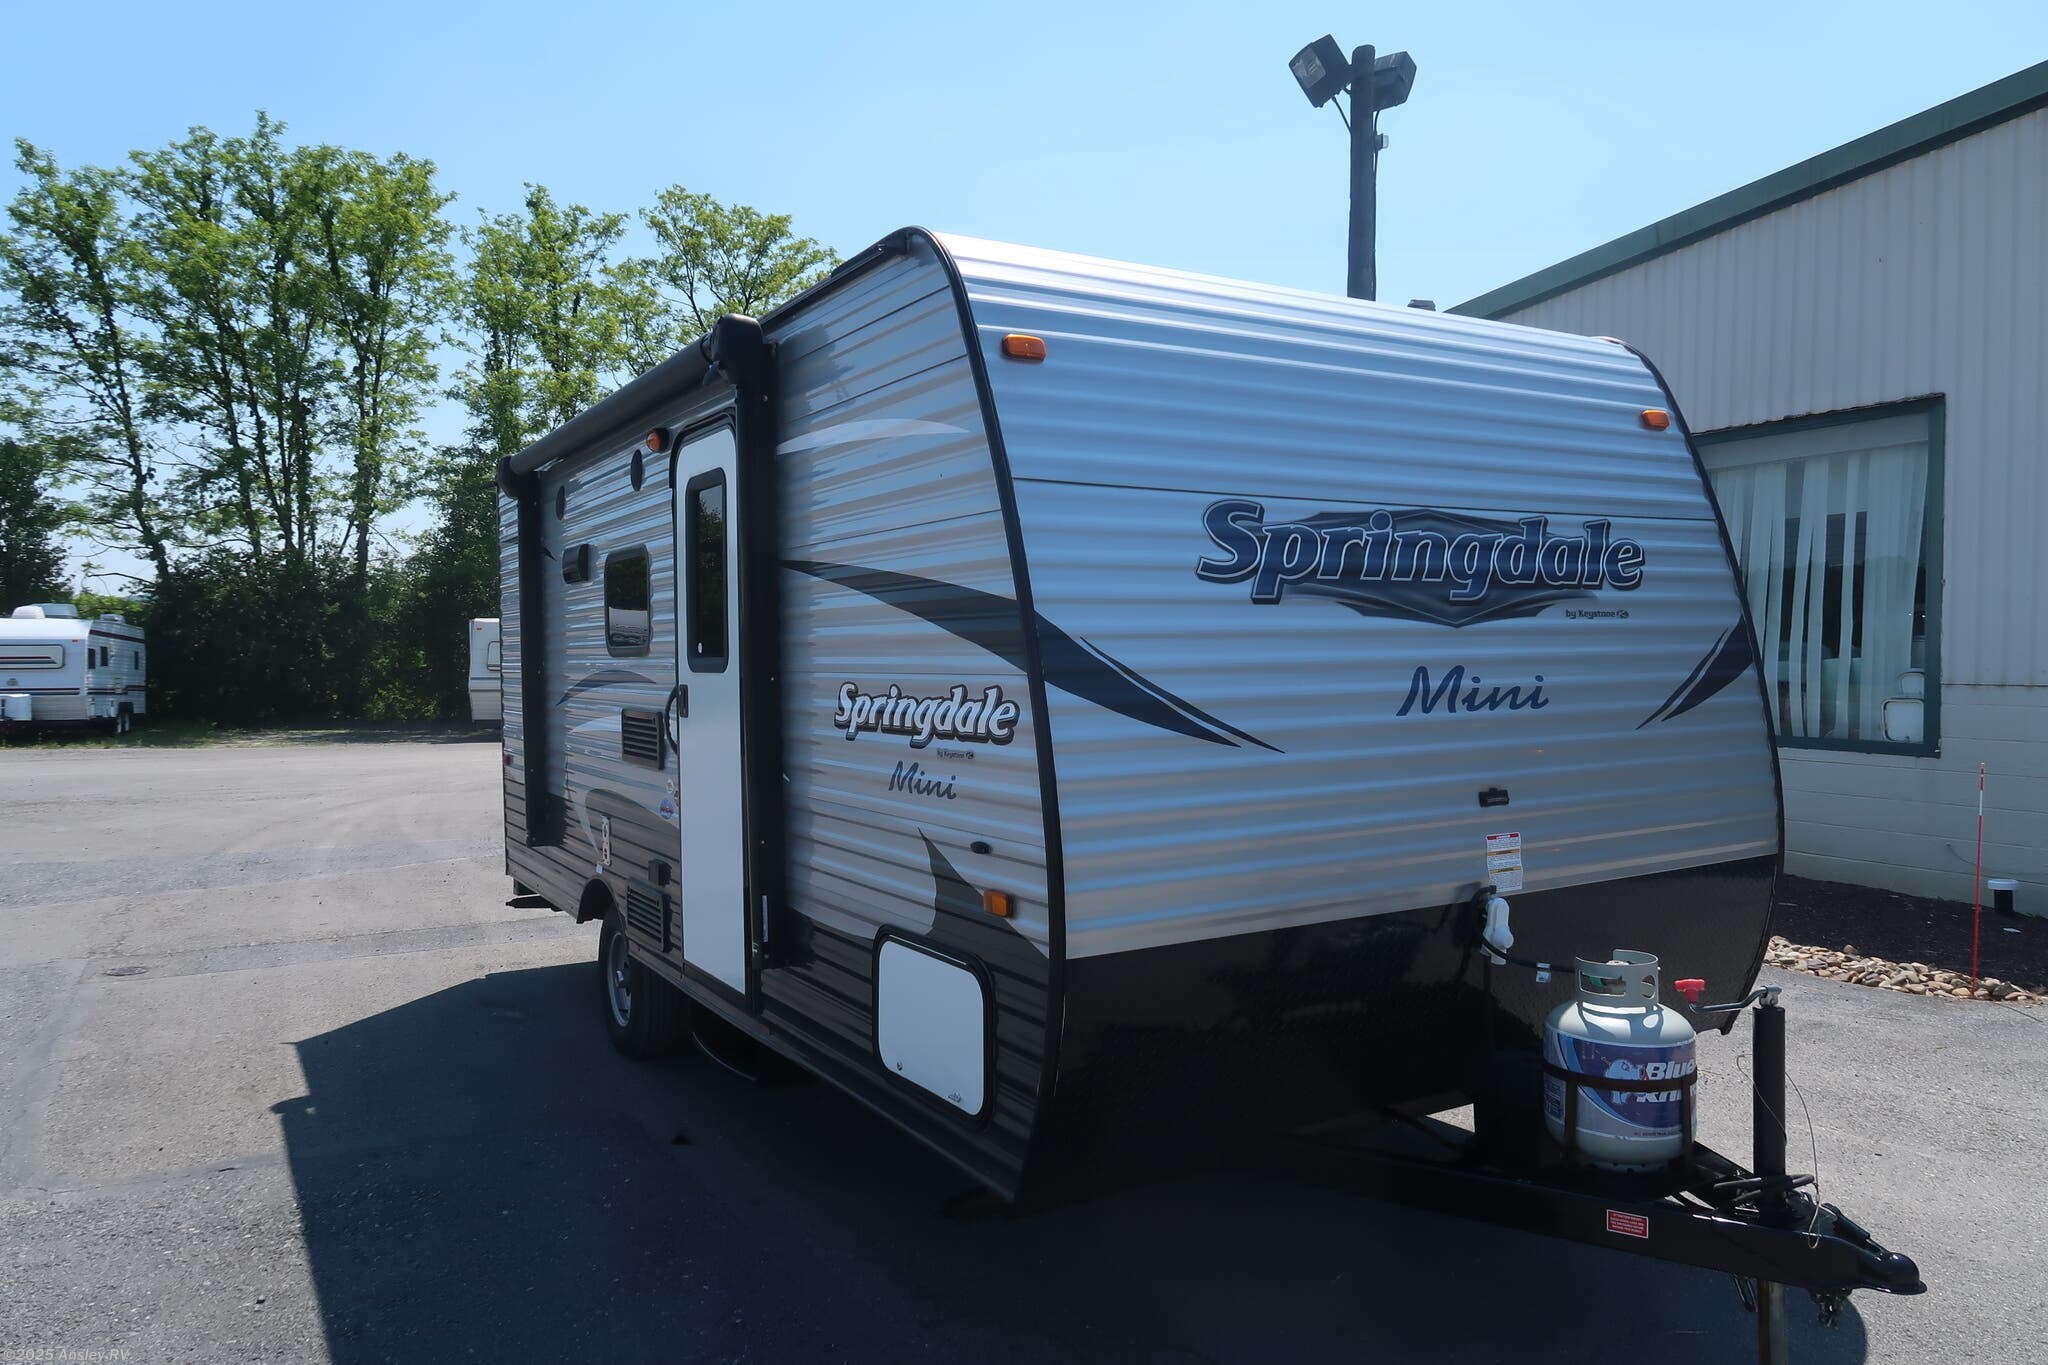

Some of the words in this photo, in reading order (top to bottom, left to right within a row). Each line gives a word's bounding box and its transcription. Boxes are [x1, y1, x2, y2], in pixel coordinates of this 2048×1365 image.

[1196, 498, 1646, 604] Springdale
[1565, 609, 1577, 619] by
[1397, 665, 1549, 717] Mini
[834, 681, 1020, 749] Springdale
[888, 760, 957, 800] Mini
[1646, 1059, 1695, 1080] Blue
